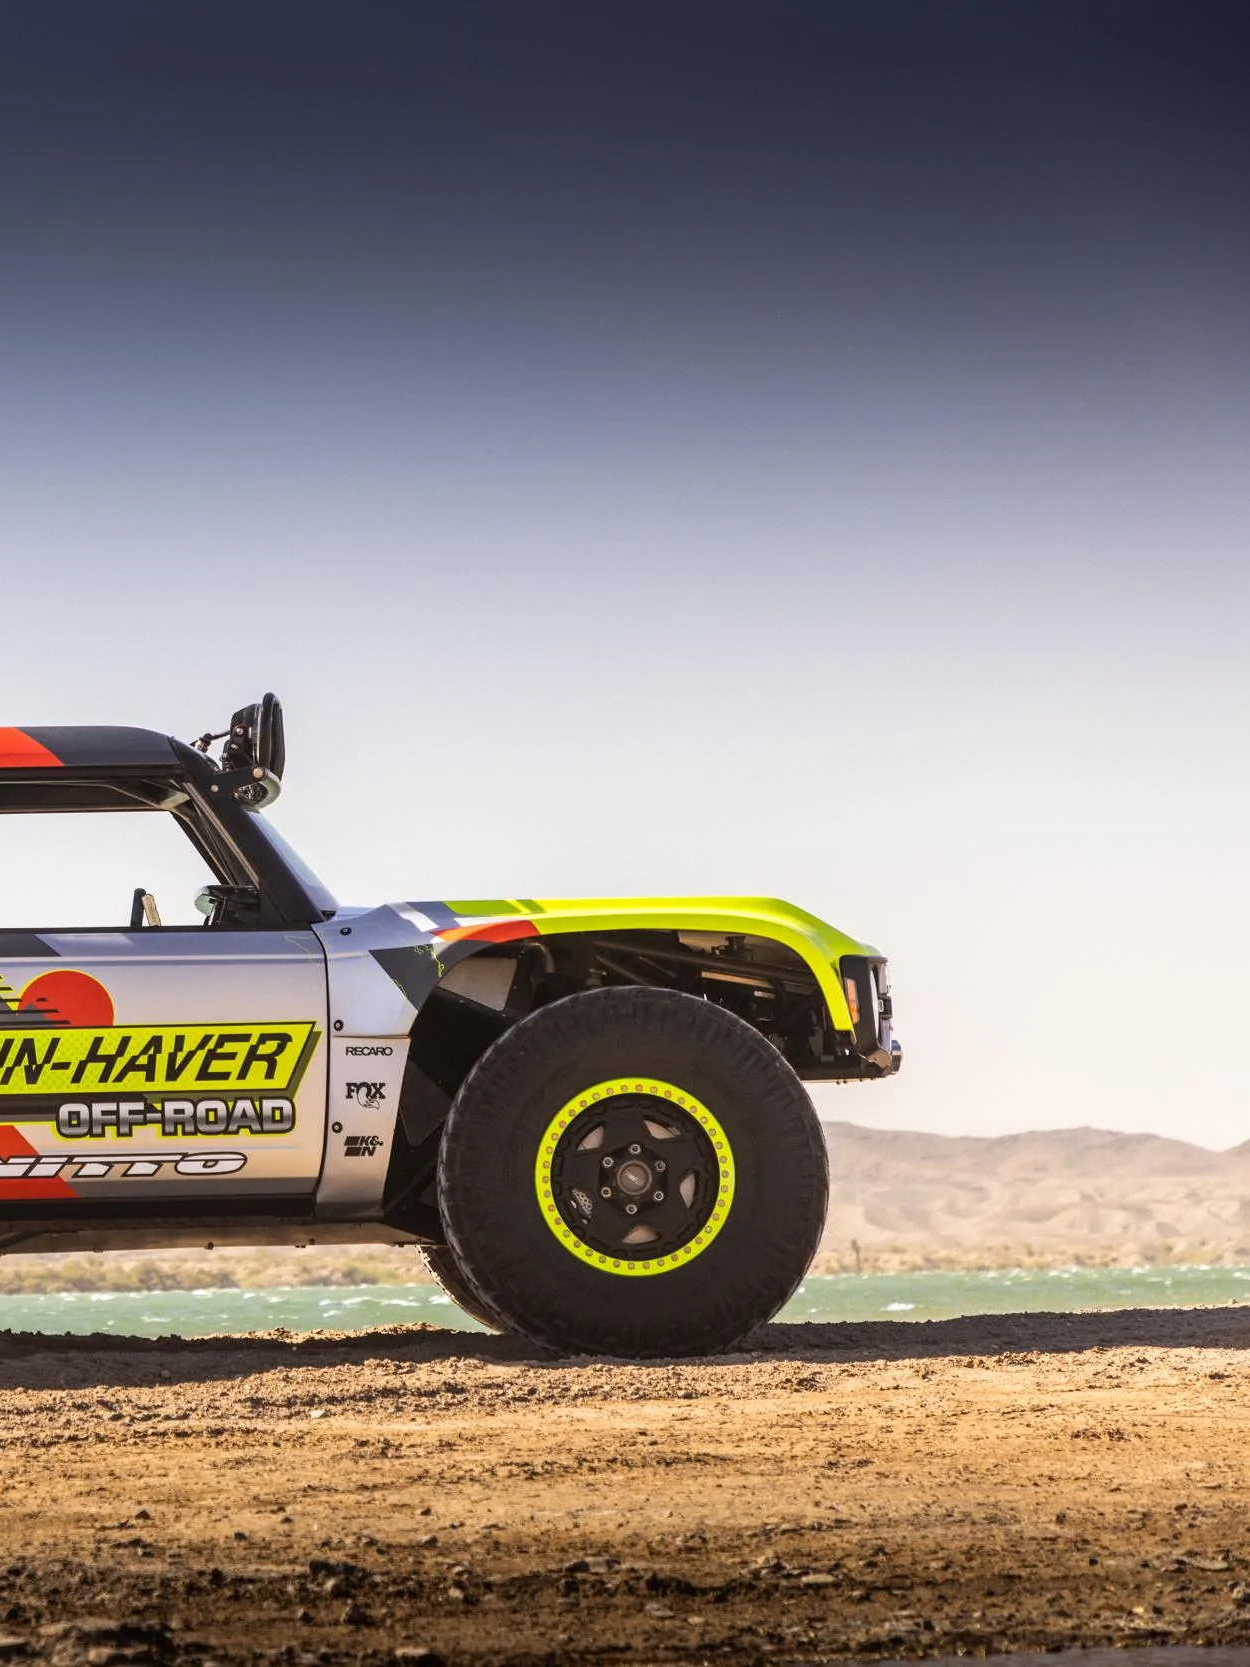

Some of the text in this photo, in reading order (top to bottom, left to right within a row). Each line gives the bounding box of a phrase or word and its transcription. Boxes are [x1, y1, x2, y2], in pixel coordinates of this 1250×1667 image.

[345, 1046, 394, 1056] RECARO
[345, 1082, 386, 1110] FOX
[56, 1099, 295, 1138] OFF-ROAD
